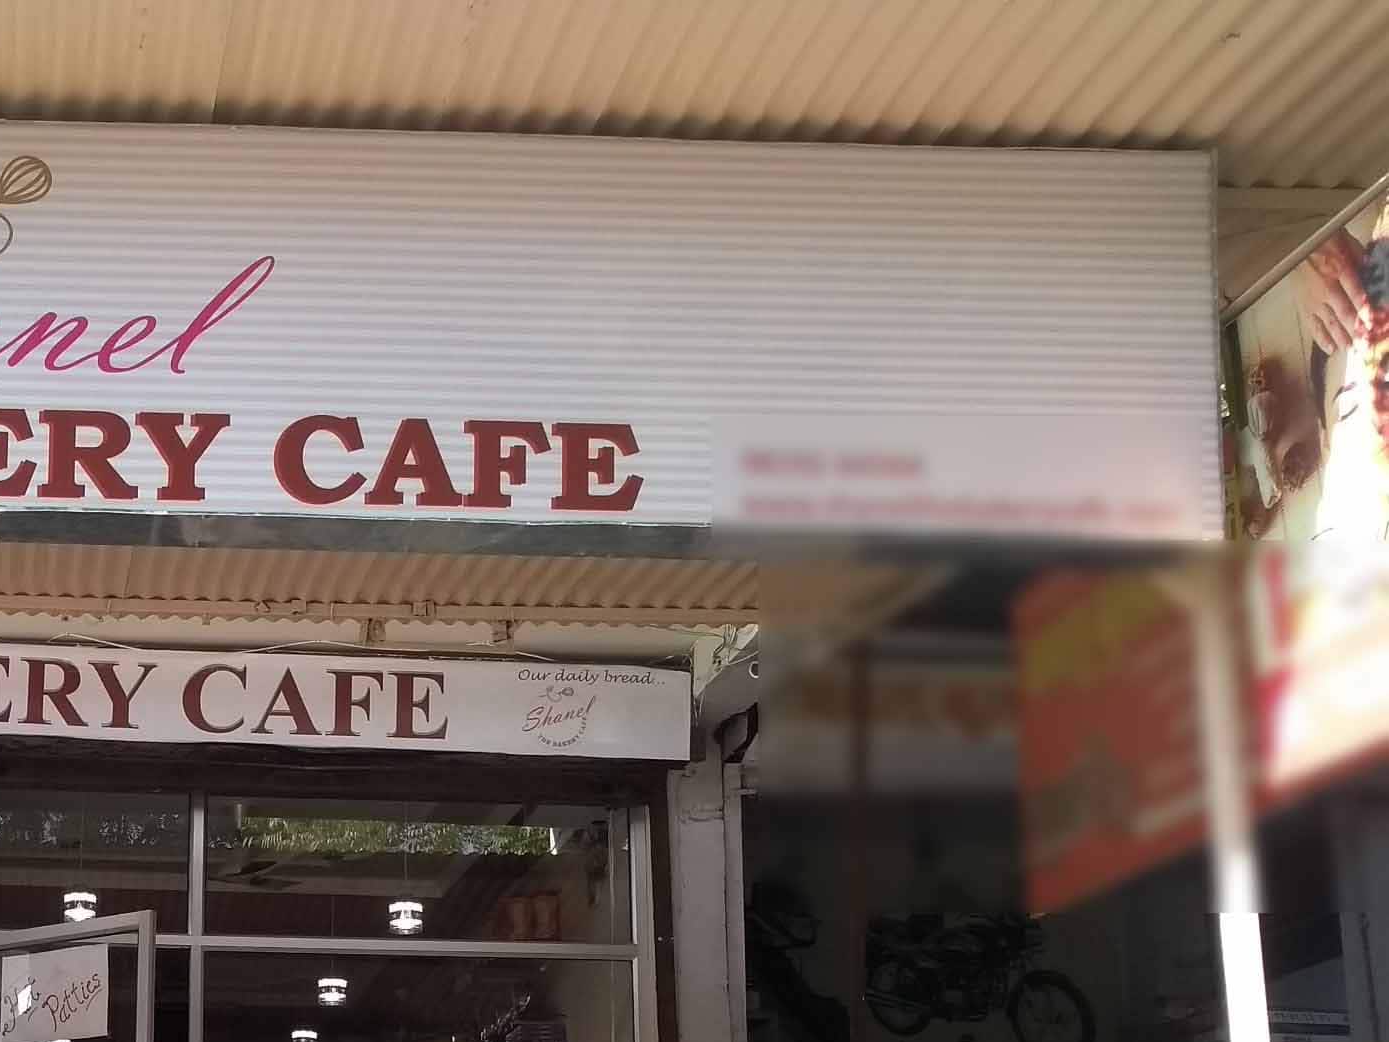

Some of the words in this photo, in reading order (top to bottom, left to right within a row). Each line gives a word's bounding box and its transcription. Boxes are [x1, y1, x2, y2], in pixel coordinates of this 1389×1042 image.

[273, 414, 644, 511] CAFE
[181, 662, 448, 740] CAFE
[518, 669, 550, 681] Our
[554, 668, 598, 685] daily
[521, 695, 597, 731] Shanel
[42, 973, 104, 1032] Patties
